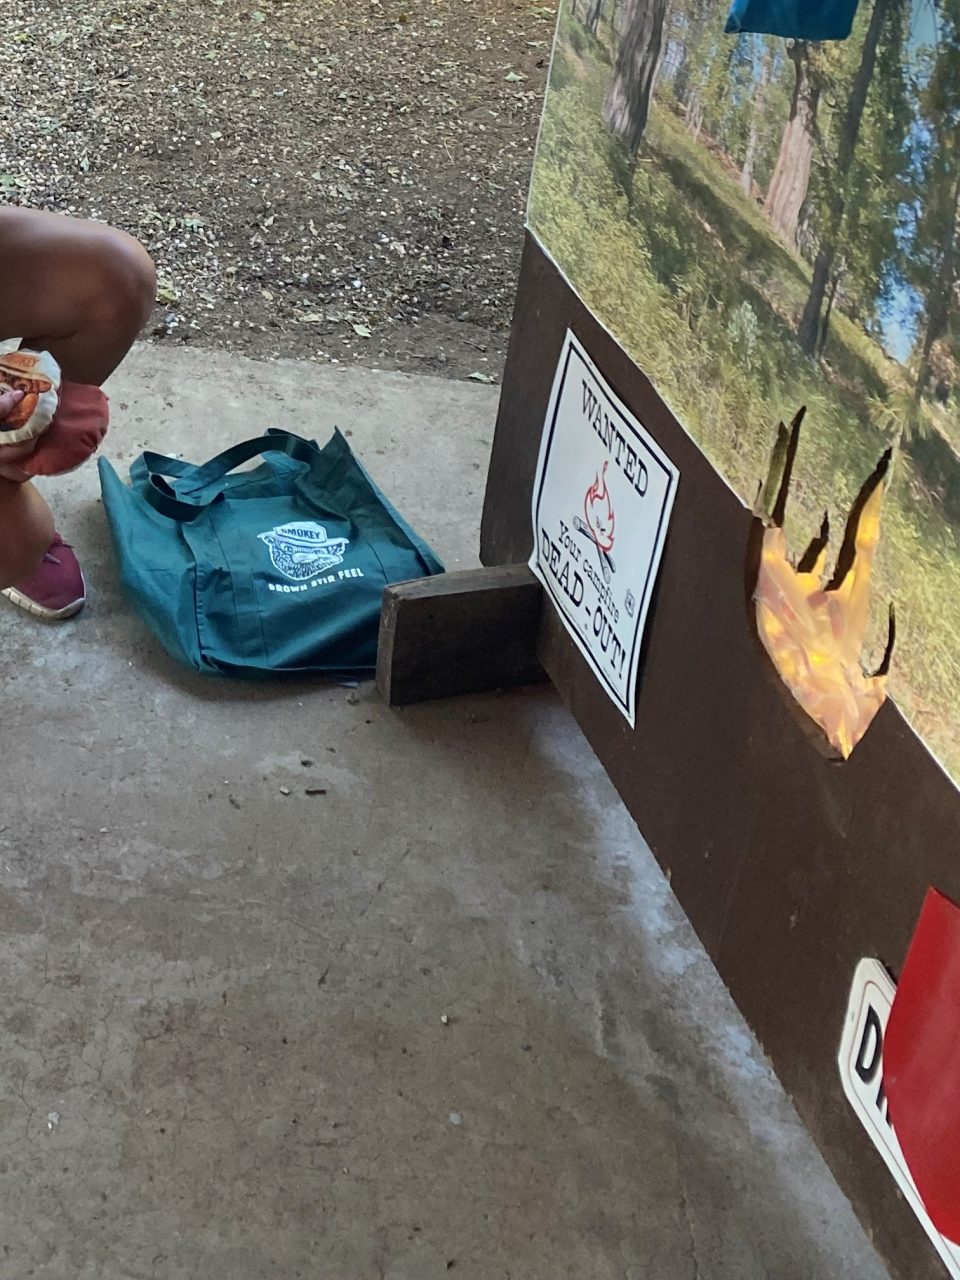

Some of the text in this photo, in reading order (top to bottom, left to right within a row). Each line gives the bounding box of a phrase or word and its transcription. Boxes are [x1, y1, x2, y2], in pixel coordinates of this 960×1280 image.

[582, 379, 649, 498] WANTED
[281, 528, 321, 540] SMOKEY
[311, 575, 336, 588] STIR
[338, 568, 364, 580] FEEL
[558, 520, 581, 563] Your
[583, 559, 620, 624] campfire
